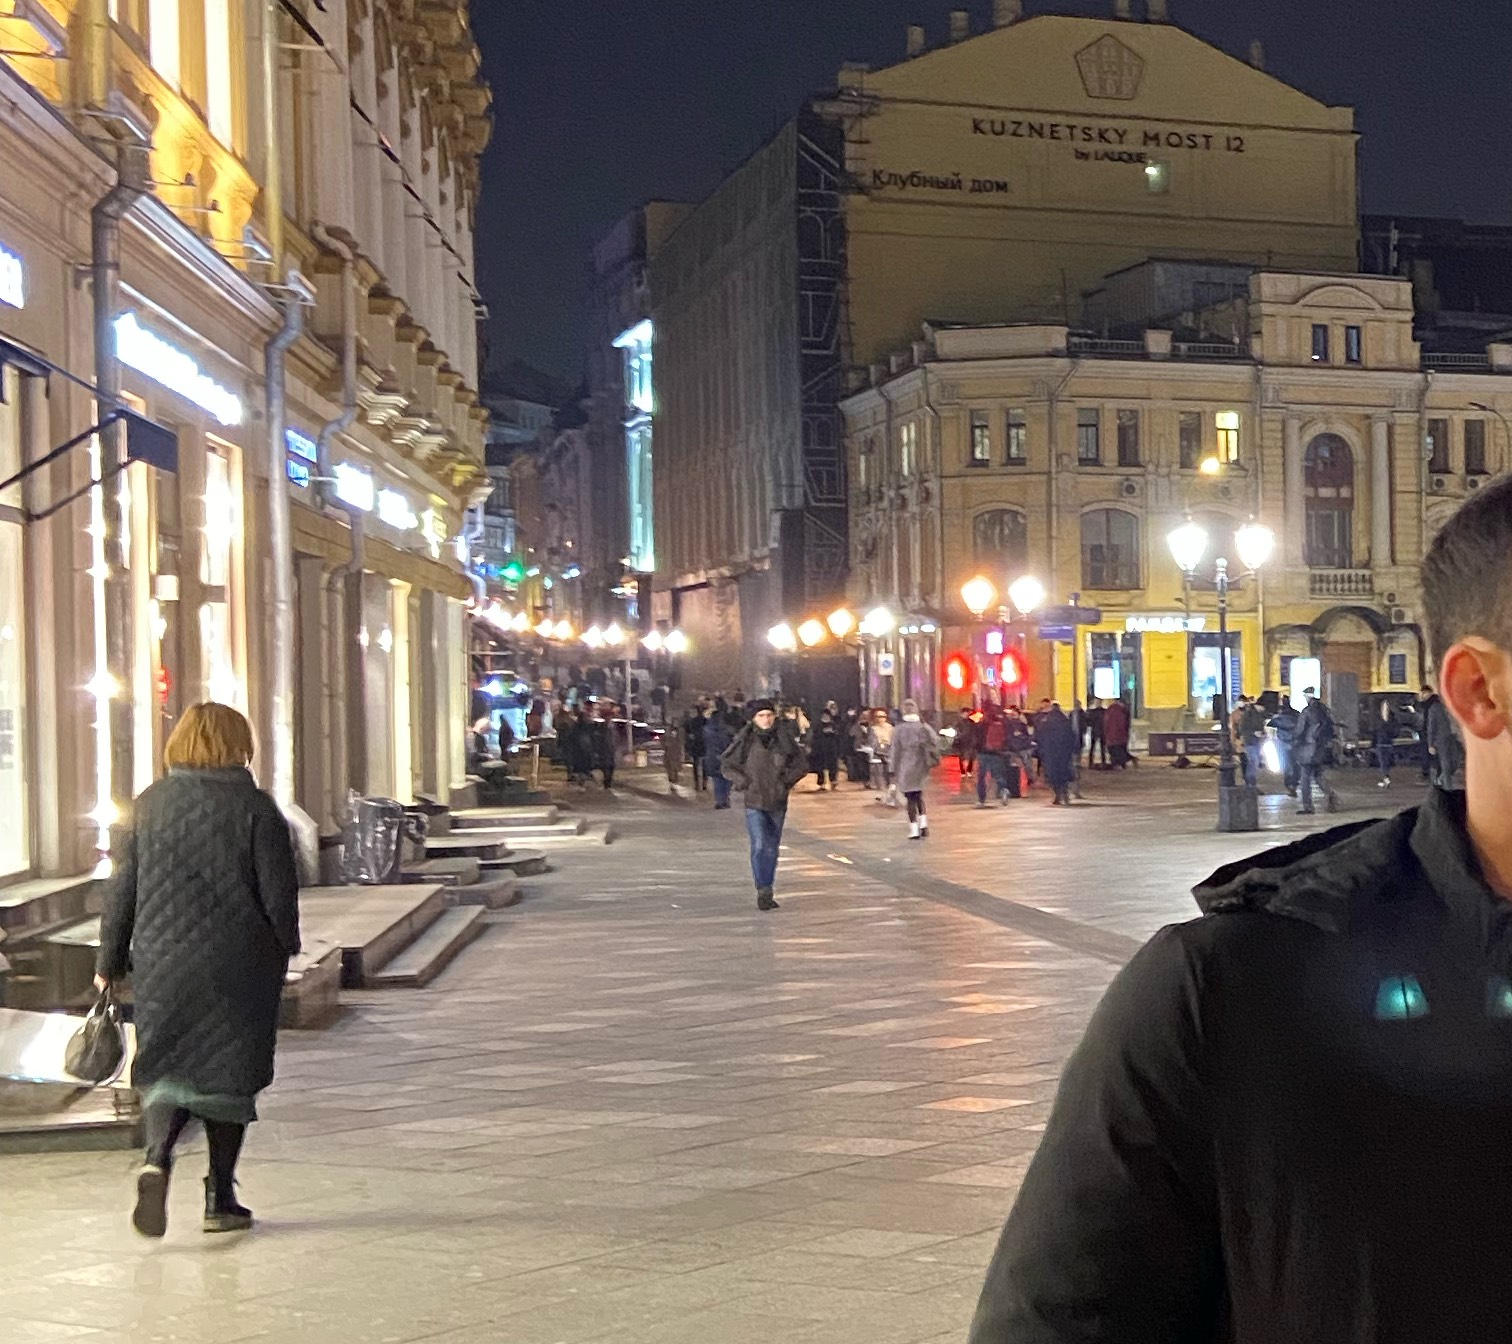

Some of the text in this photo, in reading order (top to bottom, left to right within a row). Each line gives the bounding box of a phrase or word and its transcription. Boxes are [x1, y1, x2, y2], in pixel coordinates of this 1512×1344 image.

[972, 118, 1246, 153] KUZNETSKY MOST 12
[872, 169, 1008, 193] Клубный дом
